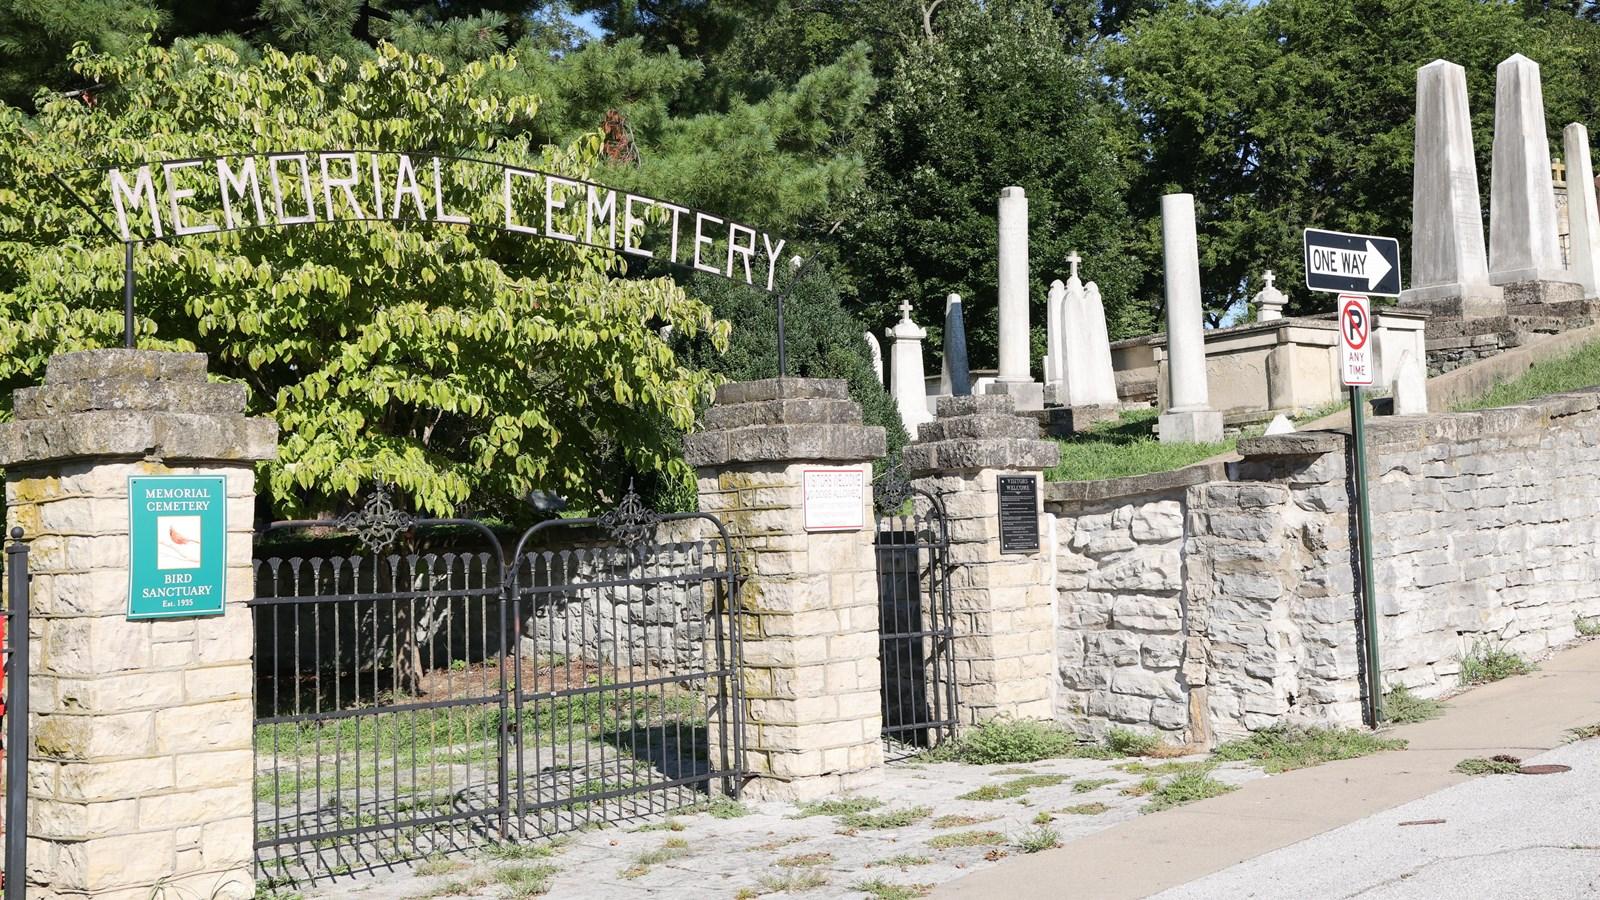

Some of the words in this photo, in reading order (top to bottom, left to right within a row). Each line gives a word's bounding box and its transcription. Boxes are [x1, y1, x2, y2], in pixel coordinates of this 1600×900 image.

[108, 152, 471, 242] MEMORIAL
[504, 167, 786, 292] CEMETERY
[1313, 248, 1338, 272] ONE
[1341, 251, 1367, 275] WAY
[1349, 352, 1364, 362] ANY
[1349, 364, 1366, 376] TIME
[145, 488, 211, 499] MEMORIAL
[146, 501, 211, 512] CEMETERY
[164, 573, 193, 584] BIRD
[142, 585, 213, 598] SANCTUARY
[162, 600, 176, 608] Est.
